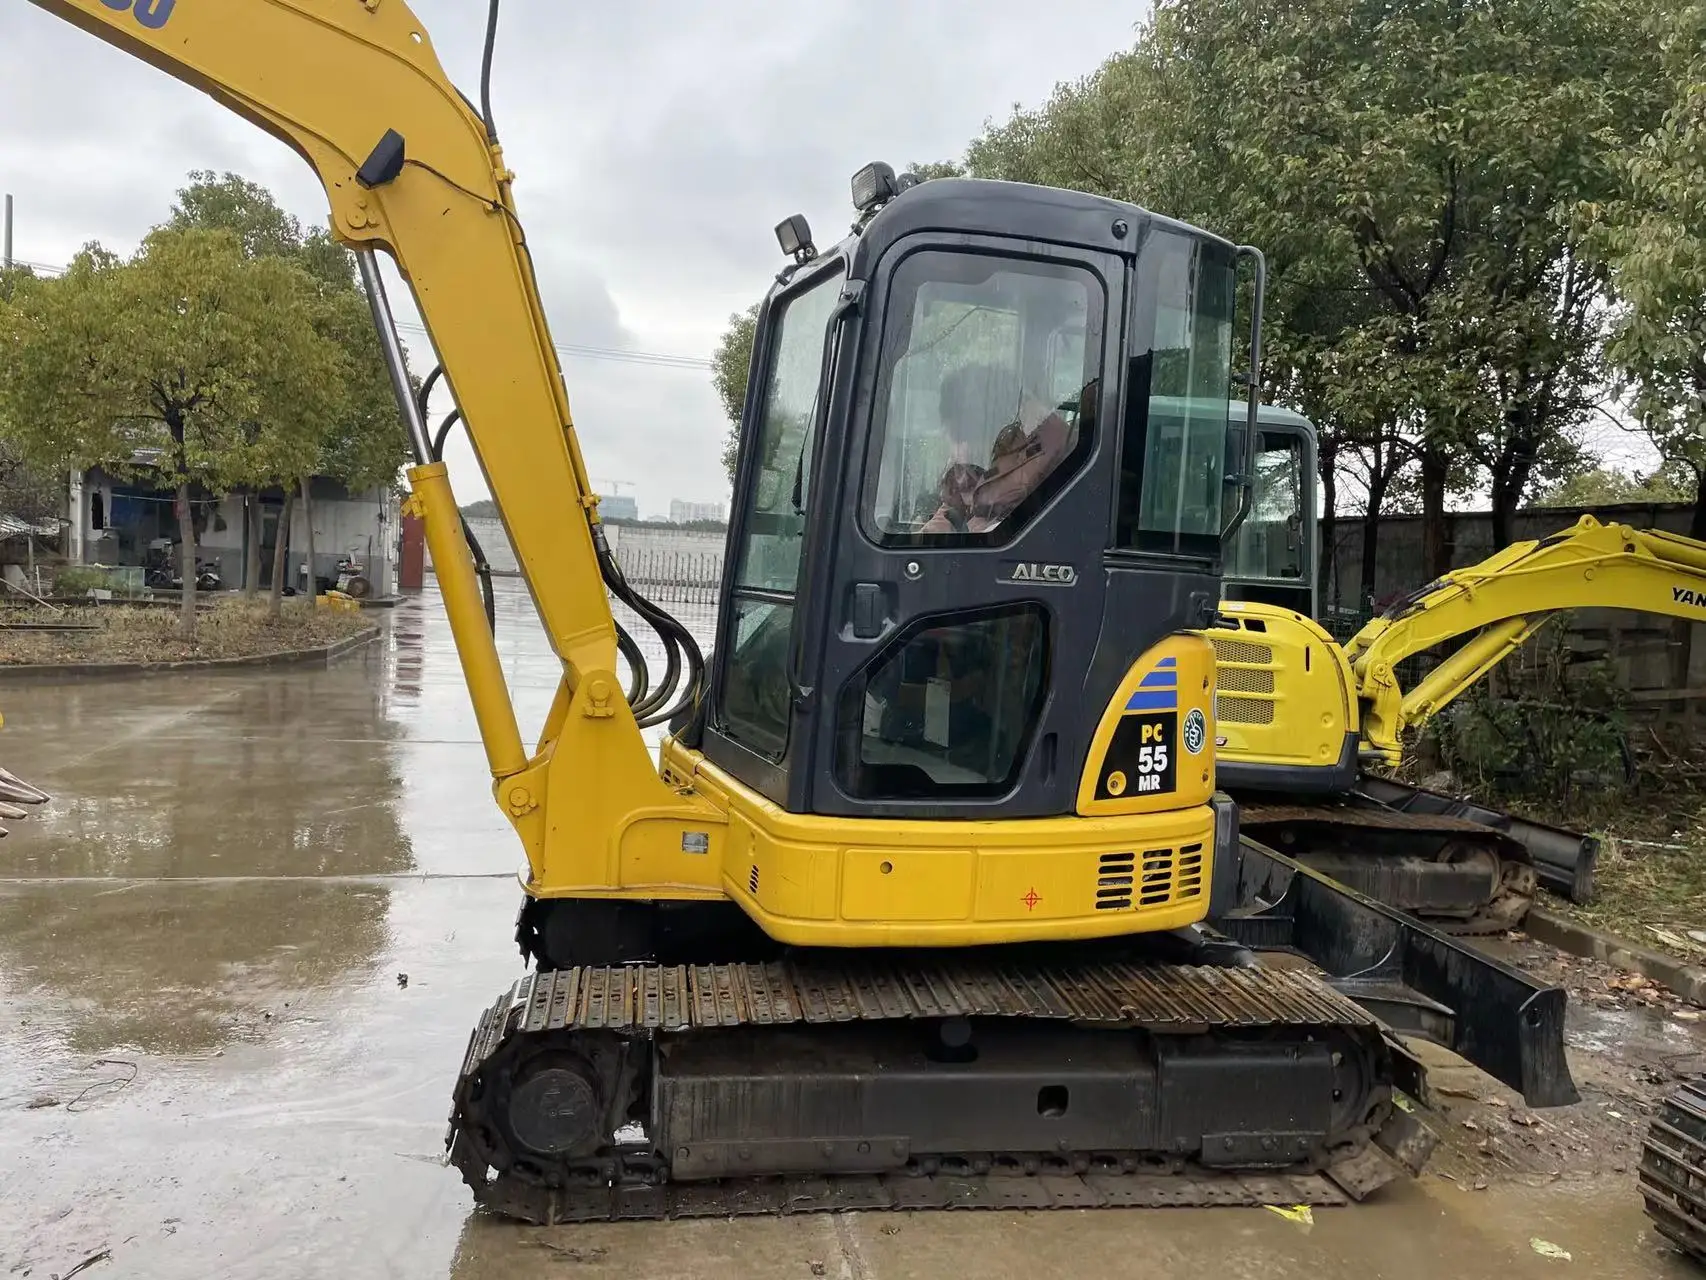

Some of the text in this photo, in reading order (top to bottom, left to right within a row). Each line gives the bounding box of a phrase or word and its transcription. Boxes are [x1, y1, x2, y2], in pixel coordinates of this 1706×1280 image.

[1141, 723, 1163, 744] PC
[1138, 745, 1168, 773] 55
[1138, 774, 1161, 792] MR
